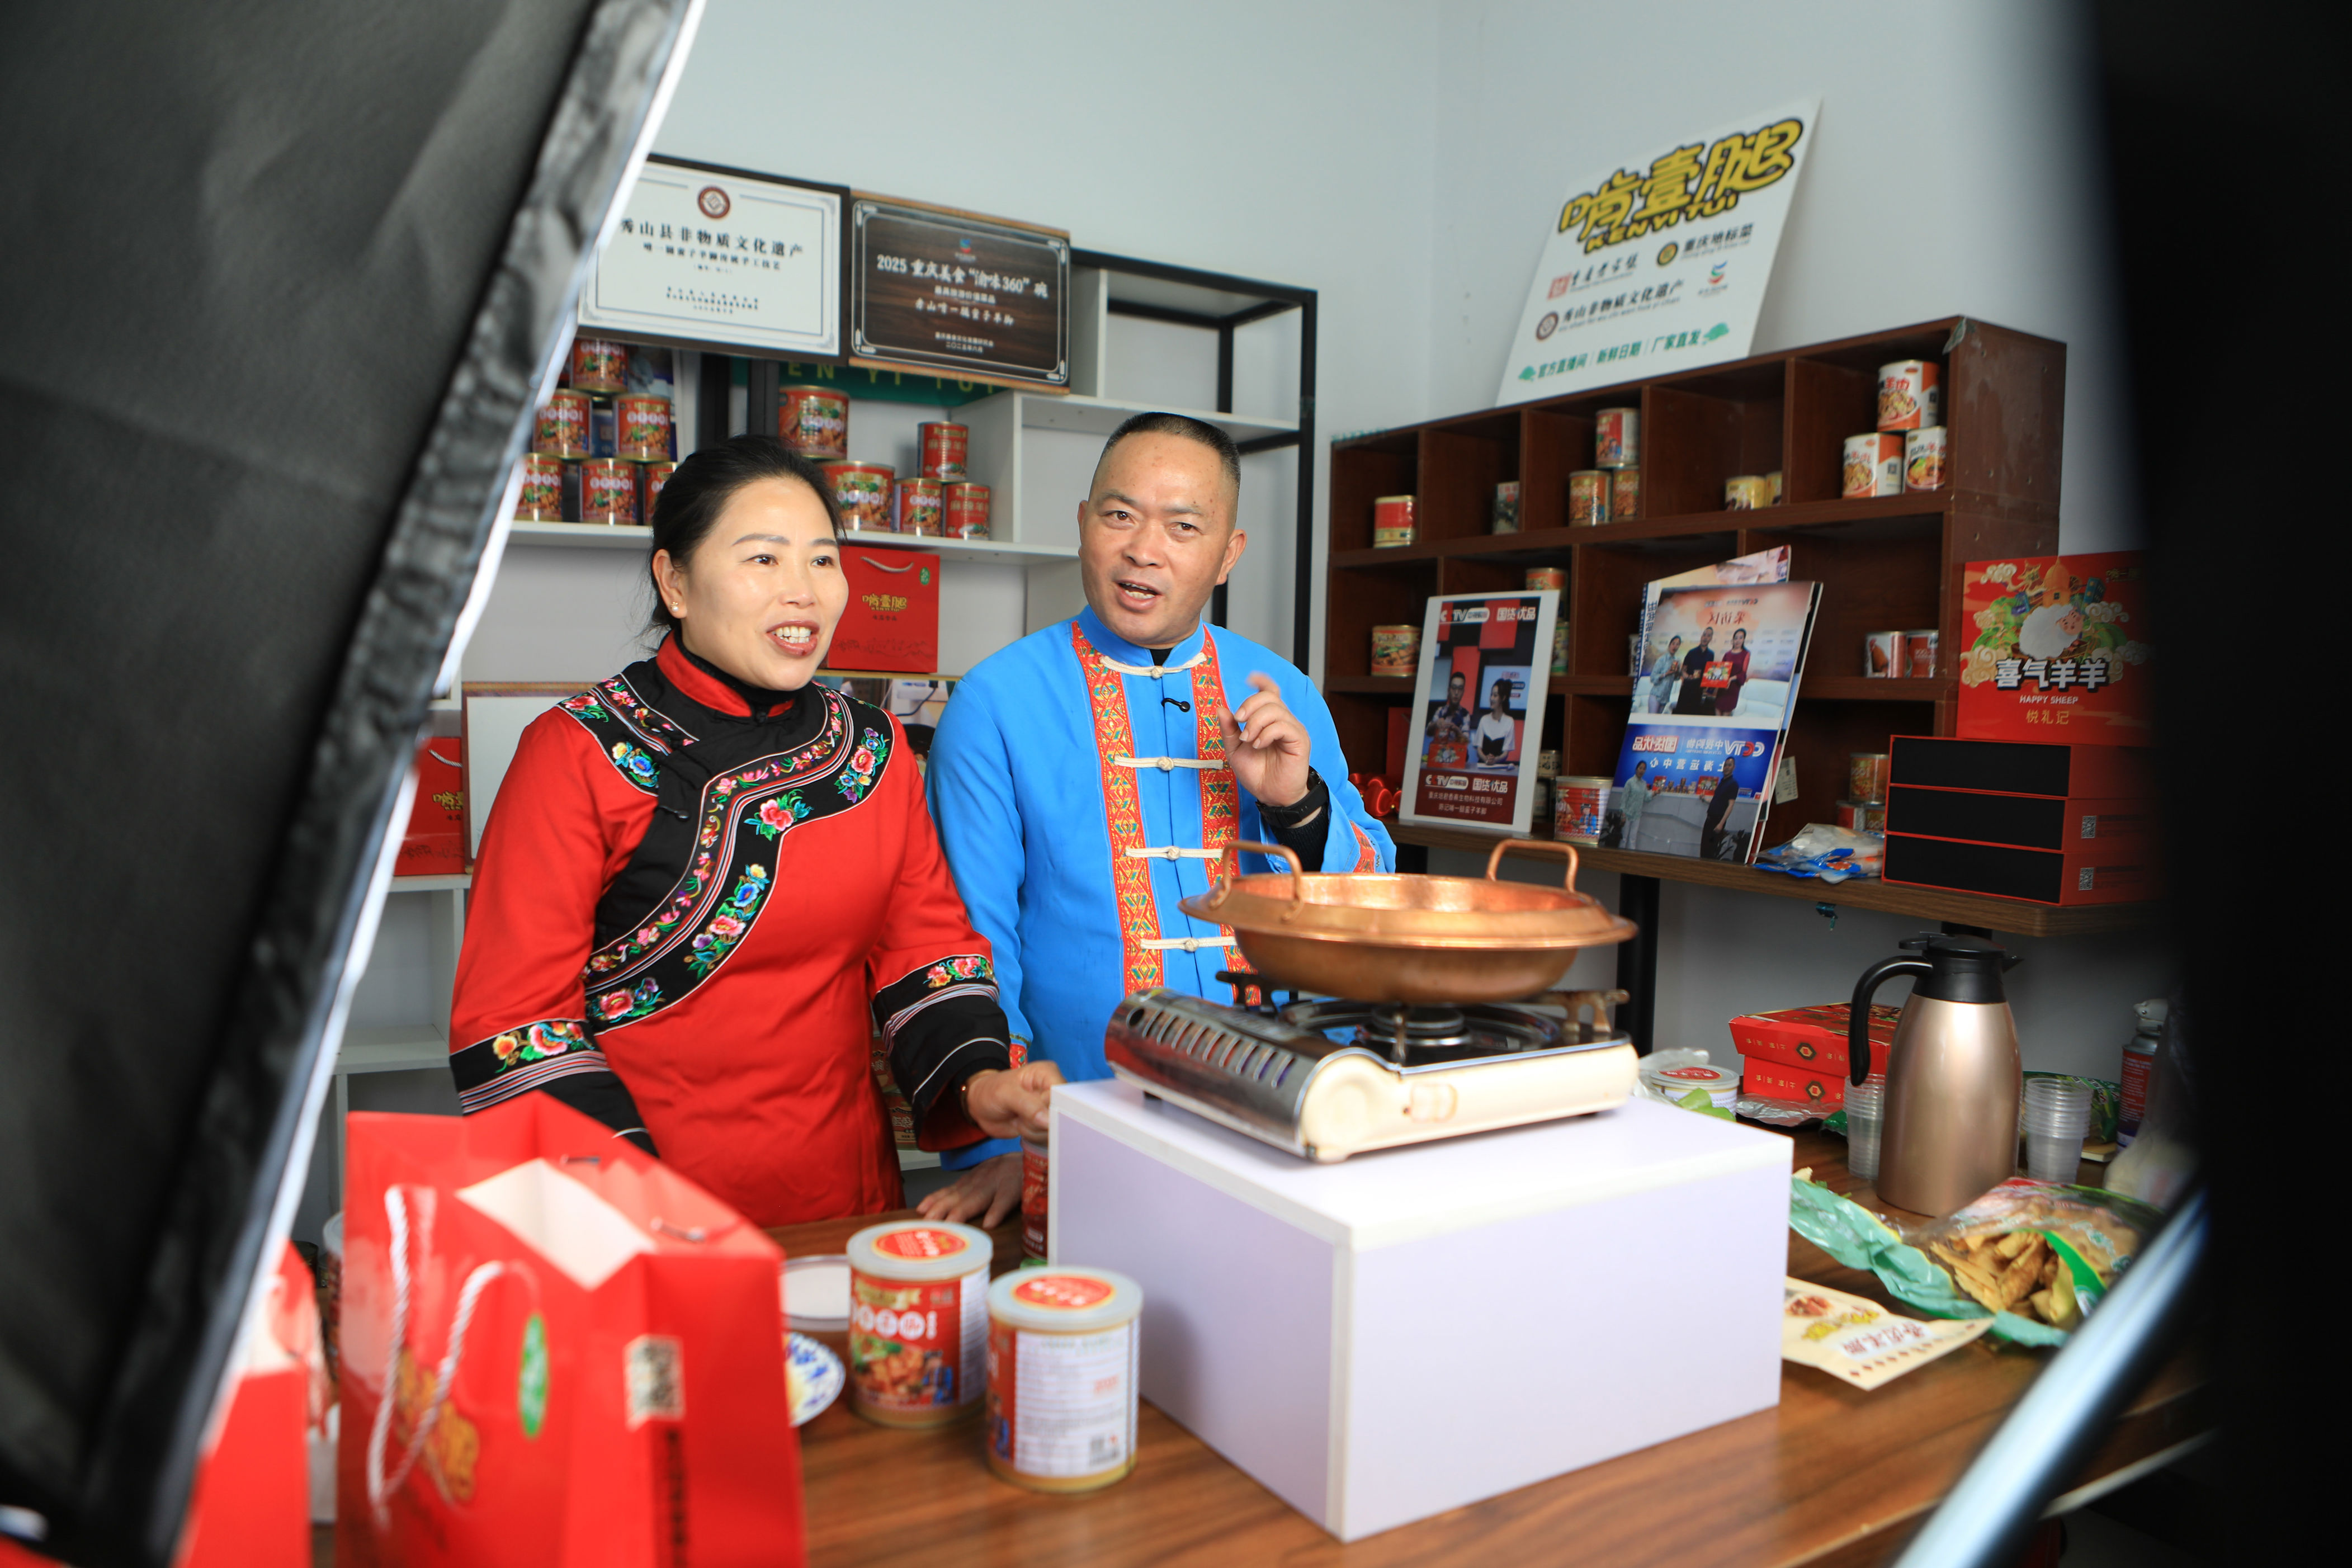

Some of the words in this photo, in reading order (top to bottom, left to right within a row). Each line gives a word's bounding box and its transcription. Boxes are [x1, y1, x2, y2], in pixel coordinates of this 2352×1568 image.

[621, 218, 803, 257] 秀山县非物质文化遗产
[1585, 220, 1649, 254] KEN
[1652, 209, 1679, 232] YI
[1684, 193, 1739, 221] TUI
[877, 254, 908, 274] 2025
[910, 258, 966, 284] 重庆美食
[1034, 281, 1049, 299] 碗
[1596, 341, 1642, 363] 新鲜日期
[1651, 329, 1702, 353] 厂家直发
[1496, 607, 1536, 622] 国货优品
[1996, 658, 2110, 691] 喜气羊羊
[2019, 695, 2048, 705] HAPPY
[2050, 696, 2079, 705] SHEEP
[2025, 709, 2070, 725] 悦礼记
[1472, 778, 1508, 793] 国货优品
